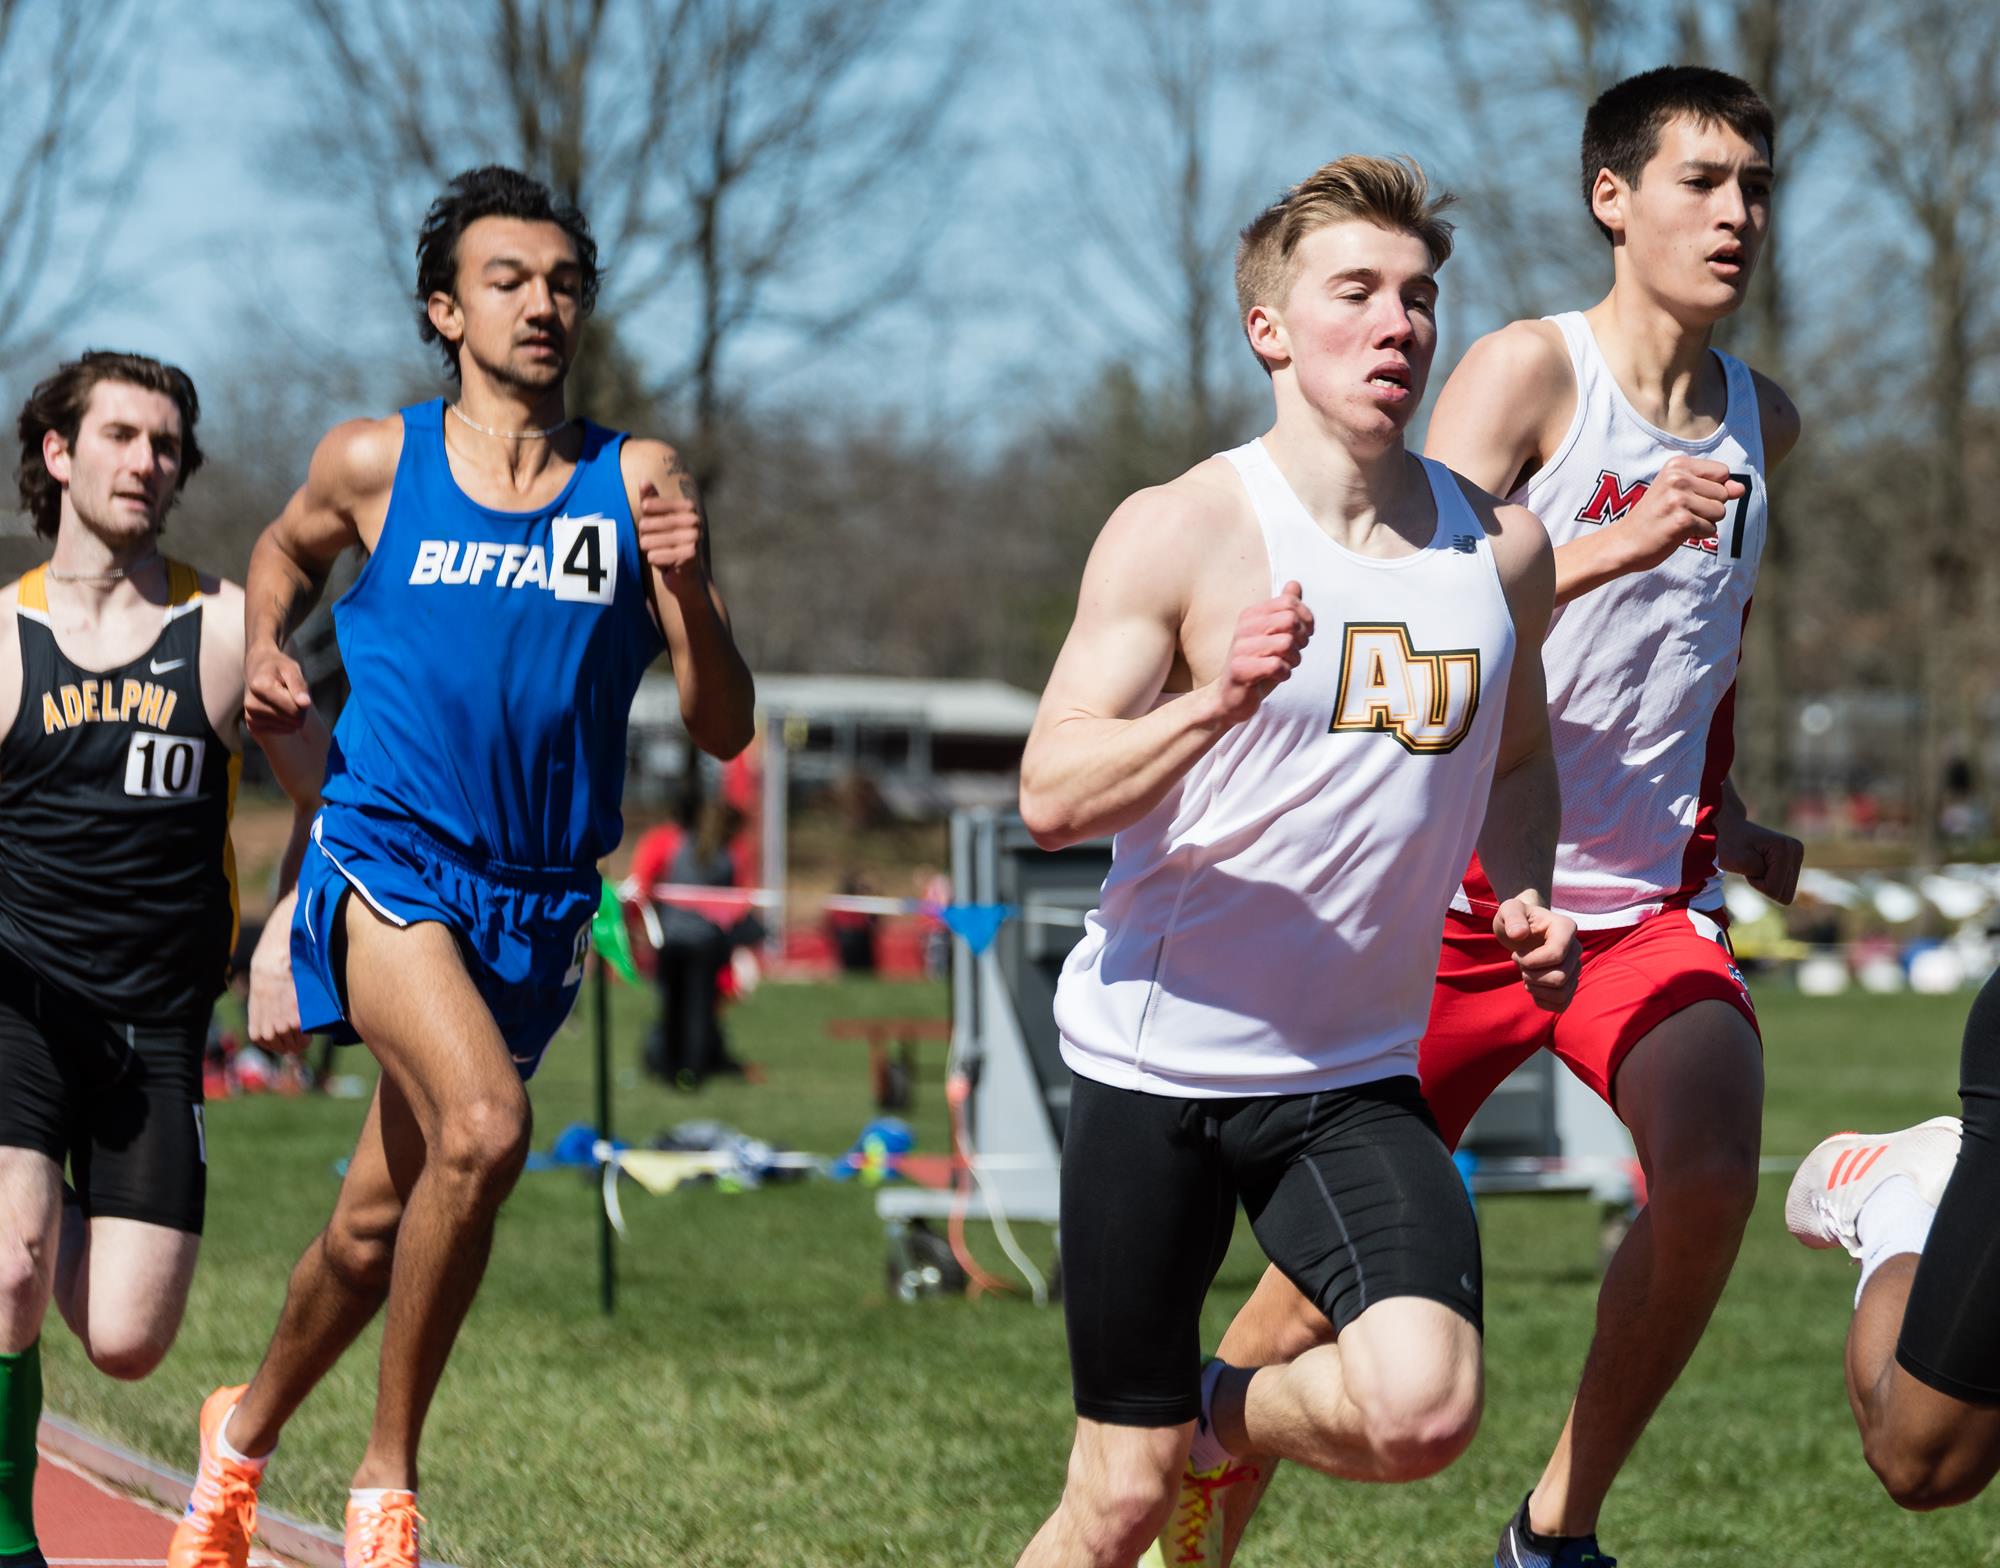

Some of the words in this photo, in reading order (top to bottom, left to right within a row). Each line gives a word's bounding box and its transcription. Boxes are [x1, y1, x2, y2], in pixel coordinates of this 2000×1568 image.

[562, 525, 608, 594] 4
[42, 678, 178, 736] ADELPHI
[1328, 621, 1480, 756] AU
[136, 739, 194, 793] 10
